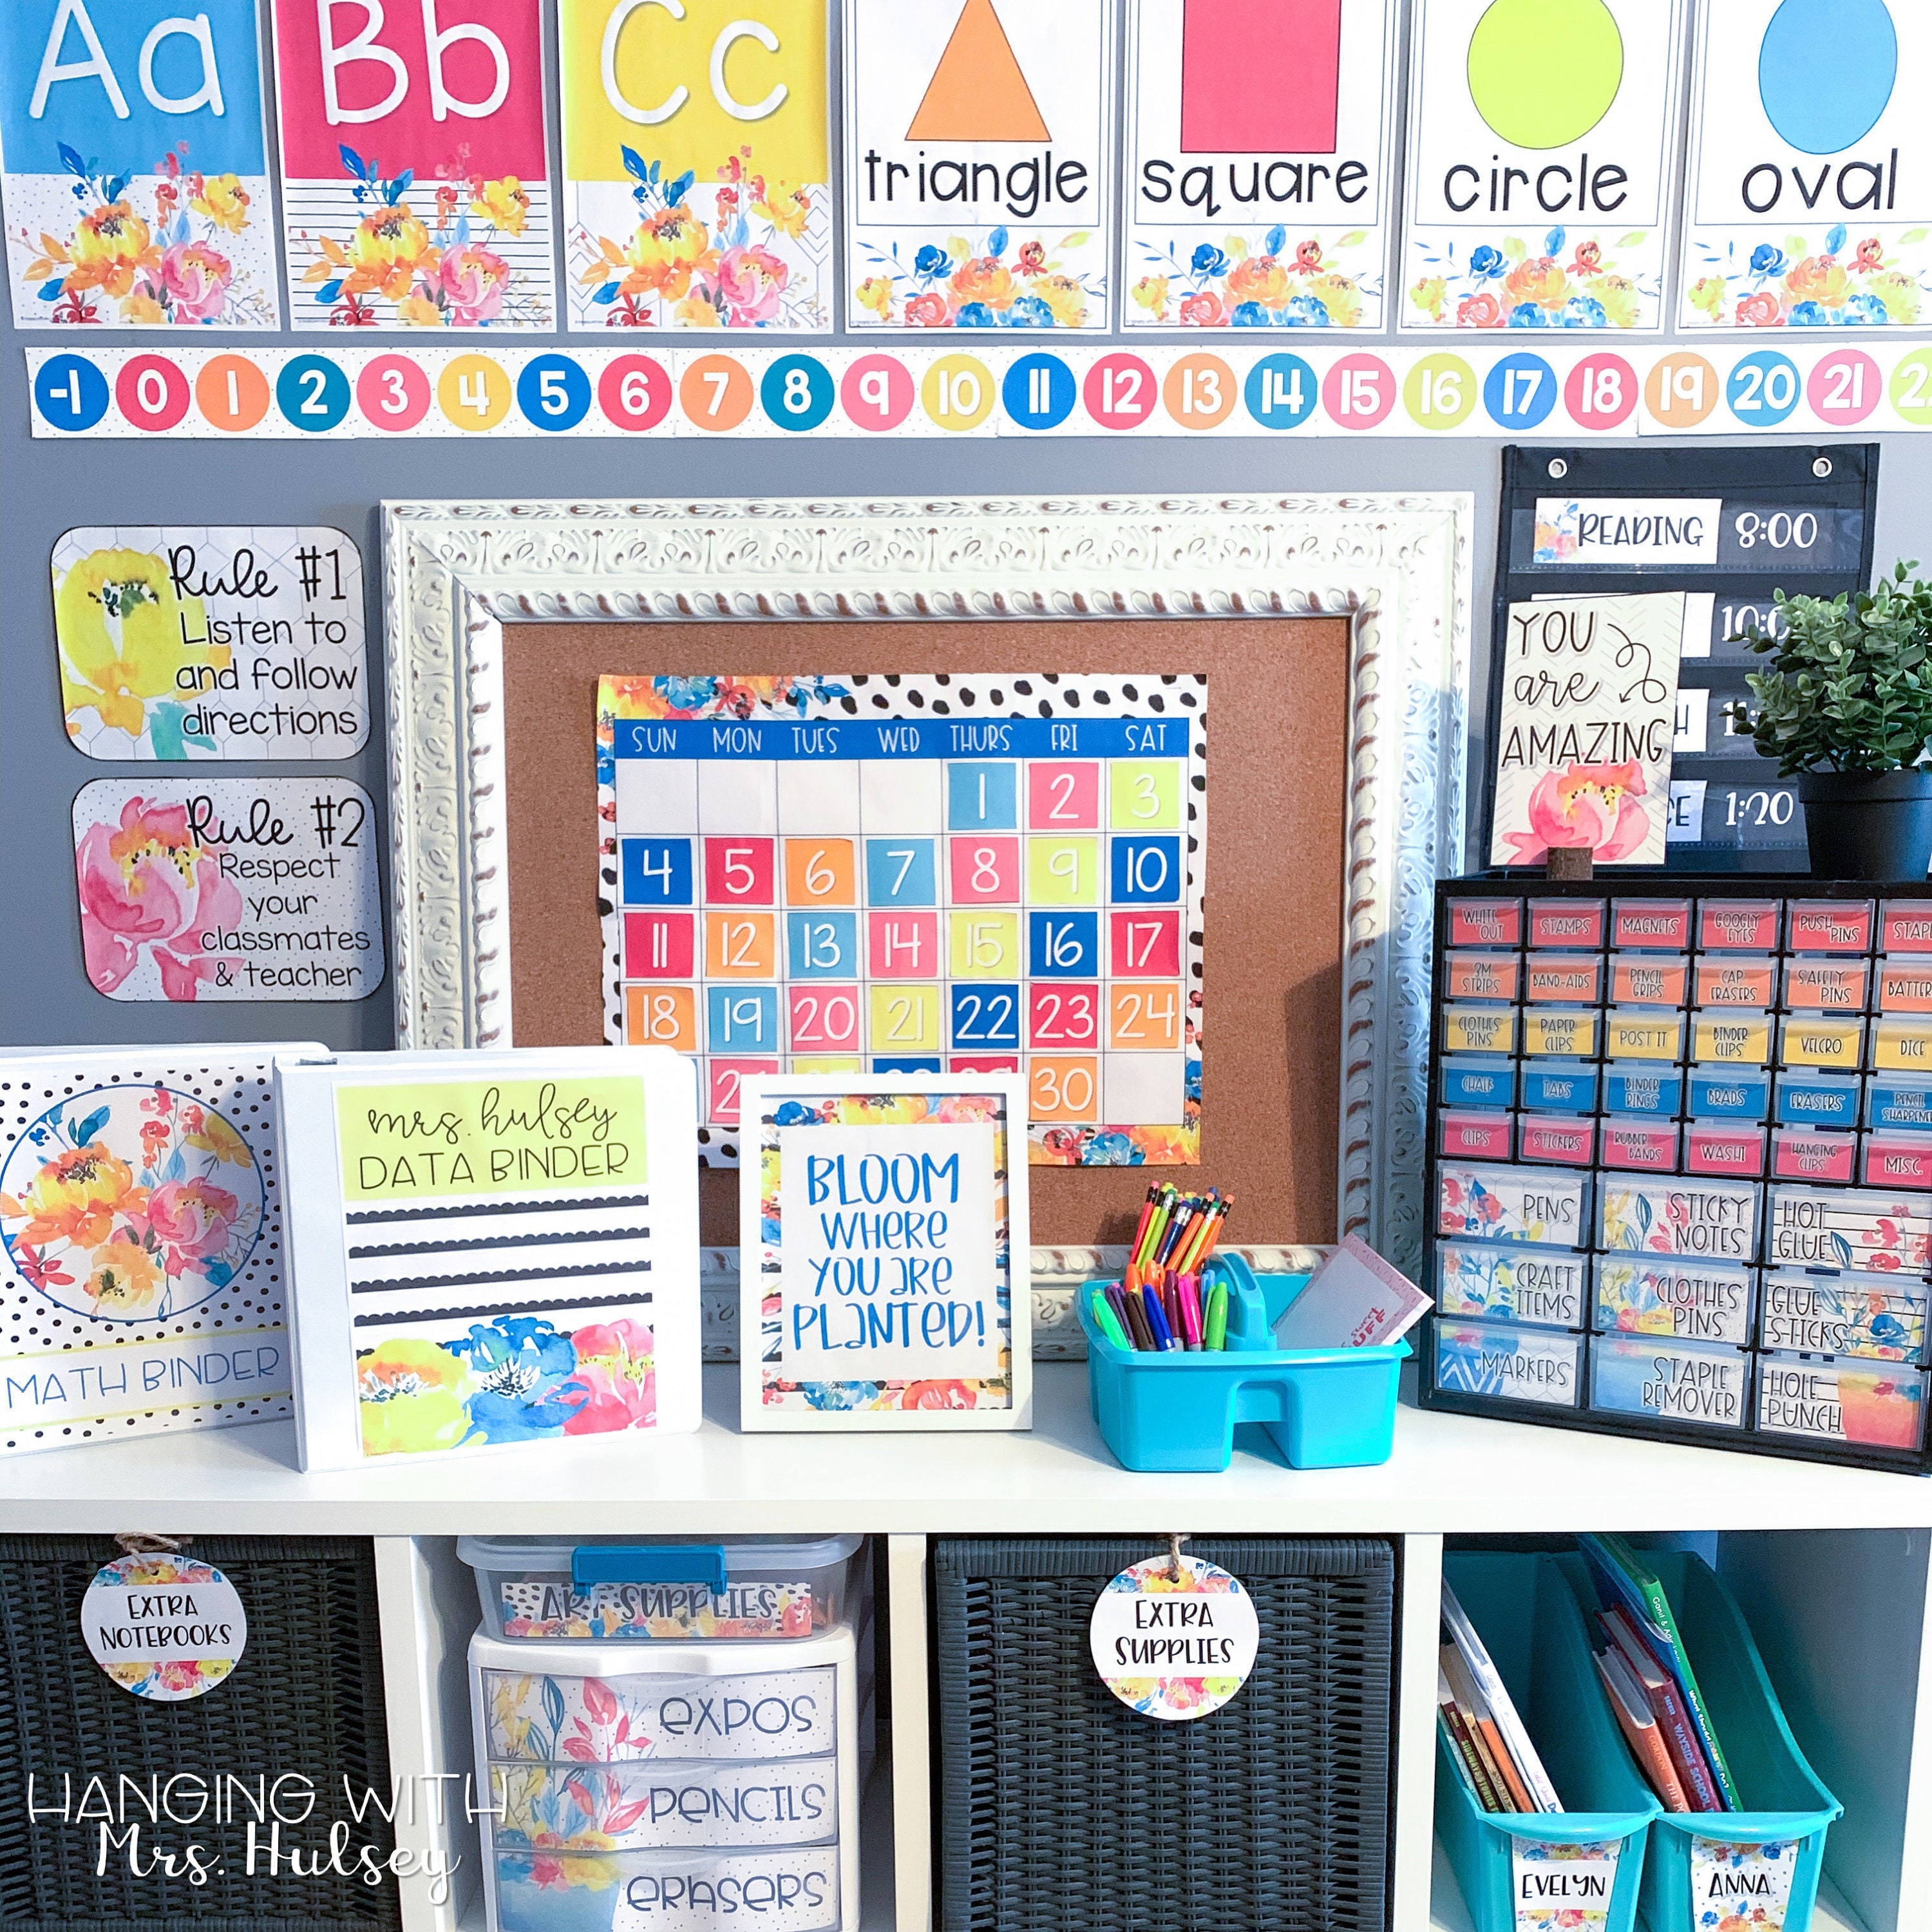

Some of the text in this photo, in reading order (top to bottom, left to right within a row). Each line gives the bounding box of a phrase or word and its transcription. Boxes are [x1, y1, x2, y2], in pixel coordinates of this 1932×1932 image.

[864, 149, 1089, 218] triangle
[1141, 160, 1368, 216] square
[1444, 153, 1627, 212] circle
[1741, 148, 1899, 213] oval
[50, 364, 1795, 417] -1 0 2 4 5 7 8 10 12 14 15 17 19 20
[1578, 512, 1817, 549] READING 8:00
[167, 545, 347, 601] Rule #1
[180, 612, 346, 645] Listen to
[1513, 611, 1594, 655] YOU
[176, 657, 357, 690] and follow
[1515, 670, 1600, 706] are
[183, 703, 357, 735] directions
[632, 724, 1167, 753] SUN MON TUES WED THURS FRI SAT
[1502, 719, 1667, 768] AMAZING
[1048, 773, 1079, 819] 2
[186, 795, 365, 849] Rule #2
[219, 852, 341, 885] Respect
[643, 847, 1168, 896] 4 5 7 10
[248, 895, 318, 922] your
[1463, 909, 1497, 924] WHITE
[1715, 913, 1760, 927] GOOGLY
[1481, 925, 1503, 940] OUT
[1540, 918, 1591, 934] STAMPS
[1622, 918, 1681, 934] MAGNETS
[1728, 929, 1756, 943] EYES
[1801, 915, 1833, 931] PUSH
[1831, 927, 1860, 942] PINS
[201, 925, 372, 951] classmates
[804, 922, 1163, 968] 13 16 17
[215, 960, 363, 987] & teacher
[1473, 963, 1492, 977] 3M
[1533, 974, 1591, 989] BAND-AIDS
[1630, 969, 1663, 983] PENCIL
[1721, 970, 1743, 984] CAP
[1798, 971, 1845, 985] SAFETY
[1463, 978, 1501, 993] STRIPS
[1633, 983, 1664, 998] GRIPS
[1711, 987, 1758, 1001] ERASERS
[1821, 988, 1853, 1003] PINS
[724, 993, 1176, 1042] 19 22 23 24
[1459, 1018, 1501, 1031] CLOTHES
[1540, 1019, 1576, 1033] PAPER
[1467, 1032, 1492, 1046] PINS
[1545, 1037, 1574, 1052] CLIPS
[1620, 1031, 1667, 1047] POST IT
[1713, 1027, 1748, 1041] BINDER
[1801, 1037, 1842, 1054] VELCRO
[1900, 1039, 1926, 1056] DICE
[1715, 1043, 1745, 1057] CLIPS
[1032, 1068, 1093, 1111] 30
[1463, 1076, 1493, 1092] CHALK
[1544, 1081, 1573, 1097] TABS
[1625, 1077, 1659, 1092] BINDER
[1709, 1090, 1747, 1106] BRADS
[368, 1083, 618, 1144] mrs. hulsey
[1625, 1094, 1660, 1109] RINGS
[1791, 1094, 1845, 1111] ERASERS
[1895, 1094, 1925, 1107] PENCIL
[1462, 1131, 1491, 1145] CLIPS
[1534, 1132, 1582, 1151] STICKERS
[1615, 1132, 1647, 1144] RUBBER
[1792, 1143, 1837, 1157] HANGING
[360, 1143, 629, 1190] DATA BINDER
[1629, 1148, 1663, 1160] BANDS
[1701, 1145, 1745, 1161] WASHI
[1799, 1158, 1826, 1171] CLIPS
[1886, 1157, 1922, 1174] MISC.
[807, 1153, 960, 1206] BLOOM
[1524, 1194, 1575, 1223] PENS
[1671, 1193, 1748, 1224] STICKY
[1784, 1201, 1827, 1229] HOT
[1676, 1225, 1745, 1253] NOTES
[1779, 1230, 1827, 1260] GLUE
[808, 1256, 880, 1297] YOU
[1517, 1262, 1573, 1291] CRAFT
[1517, 1290, 1575, 1320] ITEMS
[1656, 1277, 1742, 1309] CLOTHES
[1772, 1287, 1821, 1316] GLUE
[1673, 1307, 1726, 1337] PINS
[1770, 1318, 1848, 1349] STICKS
[6, 1347, 279, 1408] MATH BINDER
[1481, 1351, 1570, 1386] MARKERS
[1653, 1357, 1728, 1390] STAPLE
[1770, 1369, 1819, 1399] HOLE
[1643, 1382, 1736, 1417] REMOVER
[1768, 1398, 1842, 1432] PUNCH
[127, 1593, 199, 1621] EXTRA
[540, 1586, 776, 1622] ART SUPPLIES
[1135, 1600, 1214, 1629] EXTRA
[100, 1623, 232, 1651] NOTEBOOKS
[1115, 1636, 1235, 1665] SUPPLIES
[1522, 1874, 1606, 1899] EVELYN
[1709, 1873, 1770, 1898] ANNA
